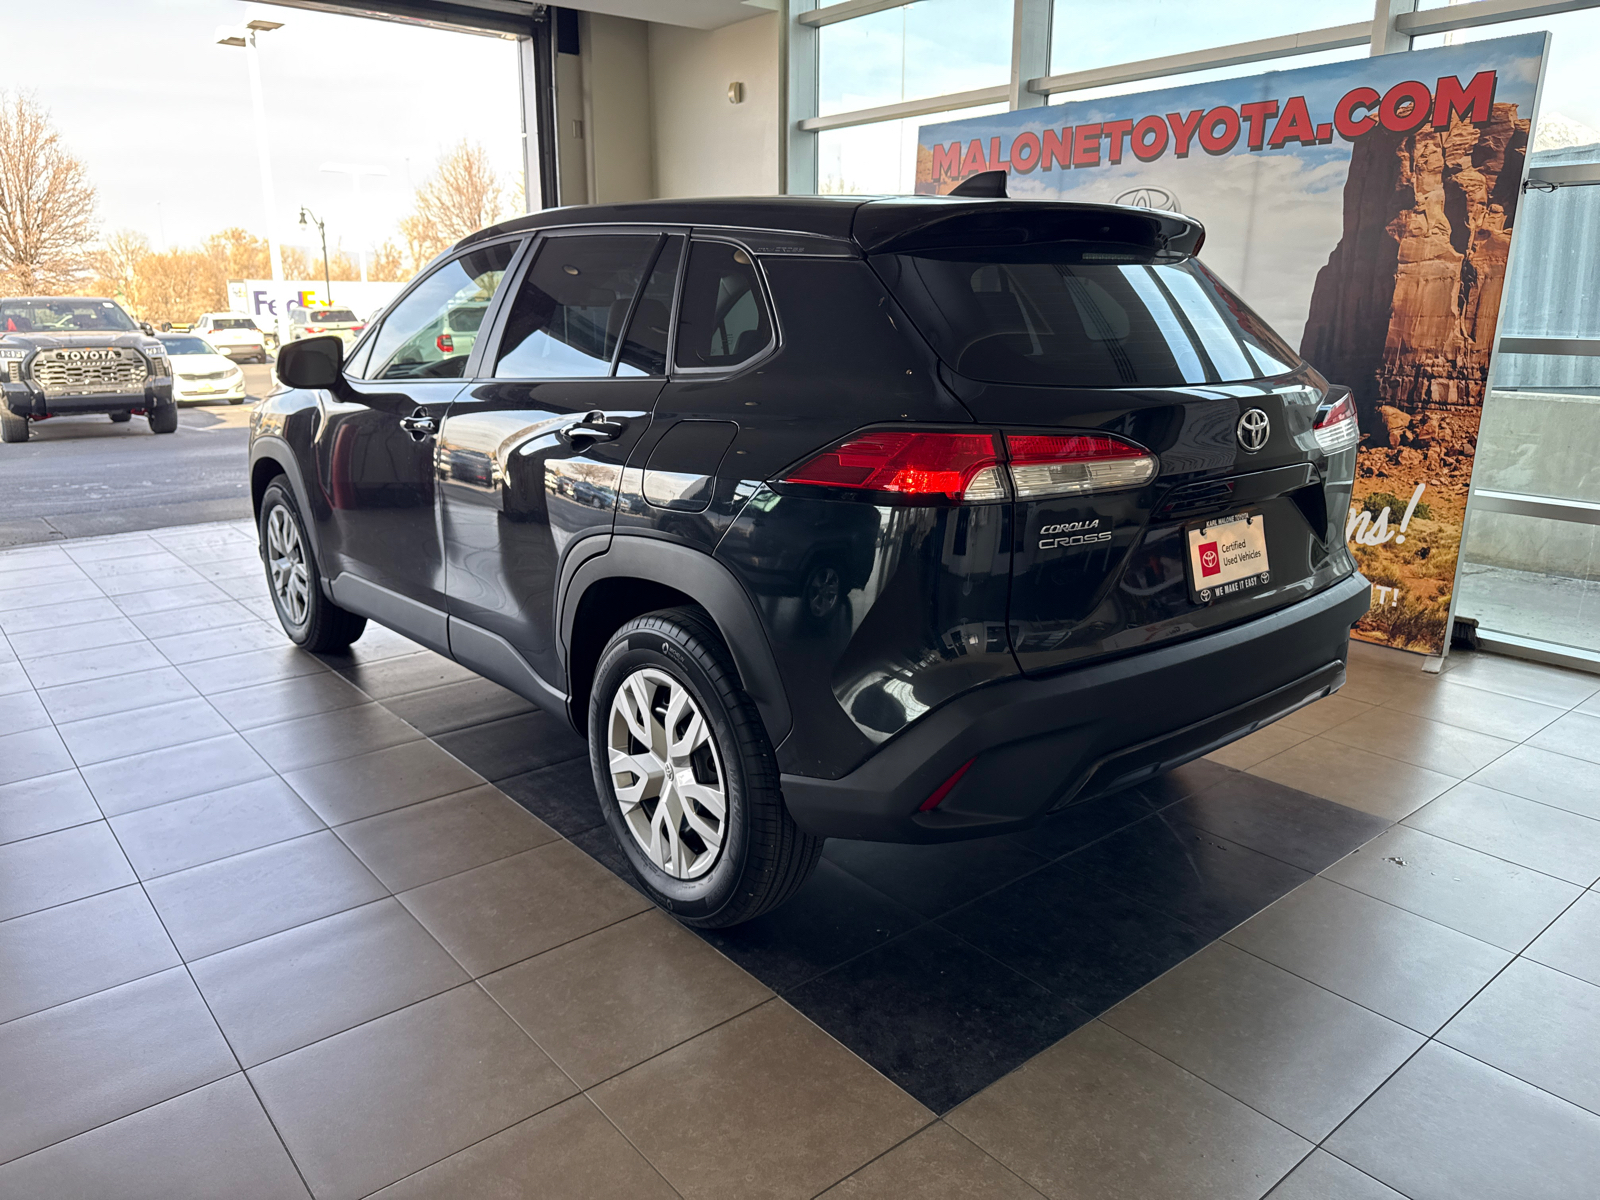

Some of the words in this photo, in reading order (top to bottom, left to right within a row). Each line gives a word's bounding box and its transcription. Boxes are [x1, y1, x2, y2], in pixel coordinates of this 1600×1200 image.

[931, 70, 1498, 182] MALONETOYOTA.COM
[62, 350, 116, 361] TOYOTA
[1040, 519, 1099, 534] COROLLA
[1218, 515, 1235, 525] MALONE
[1039, 531, 1112, 549] CROSS
[1221, 539, 1247, 553] Certified
[1223, 554, 1238, 566] Used
[1238, 549, 1262, 562] Vehicles
[1215, 586, 1224, 597] WE
[1224, 582, 1239, 594] MAKE
[1239, 580, 1245, 590] IT
[1245, 576, 1258, 588] EASY
[1371, 583, 1399, 607] T!
